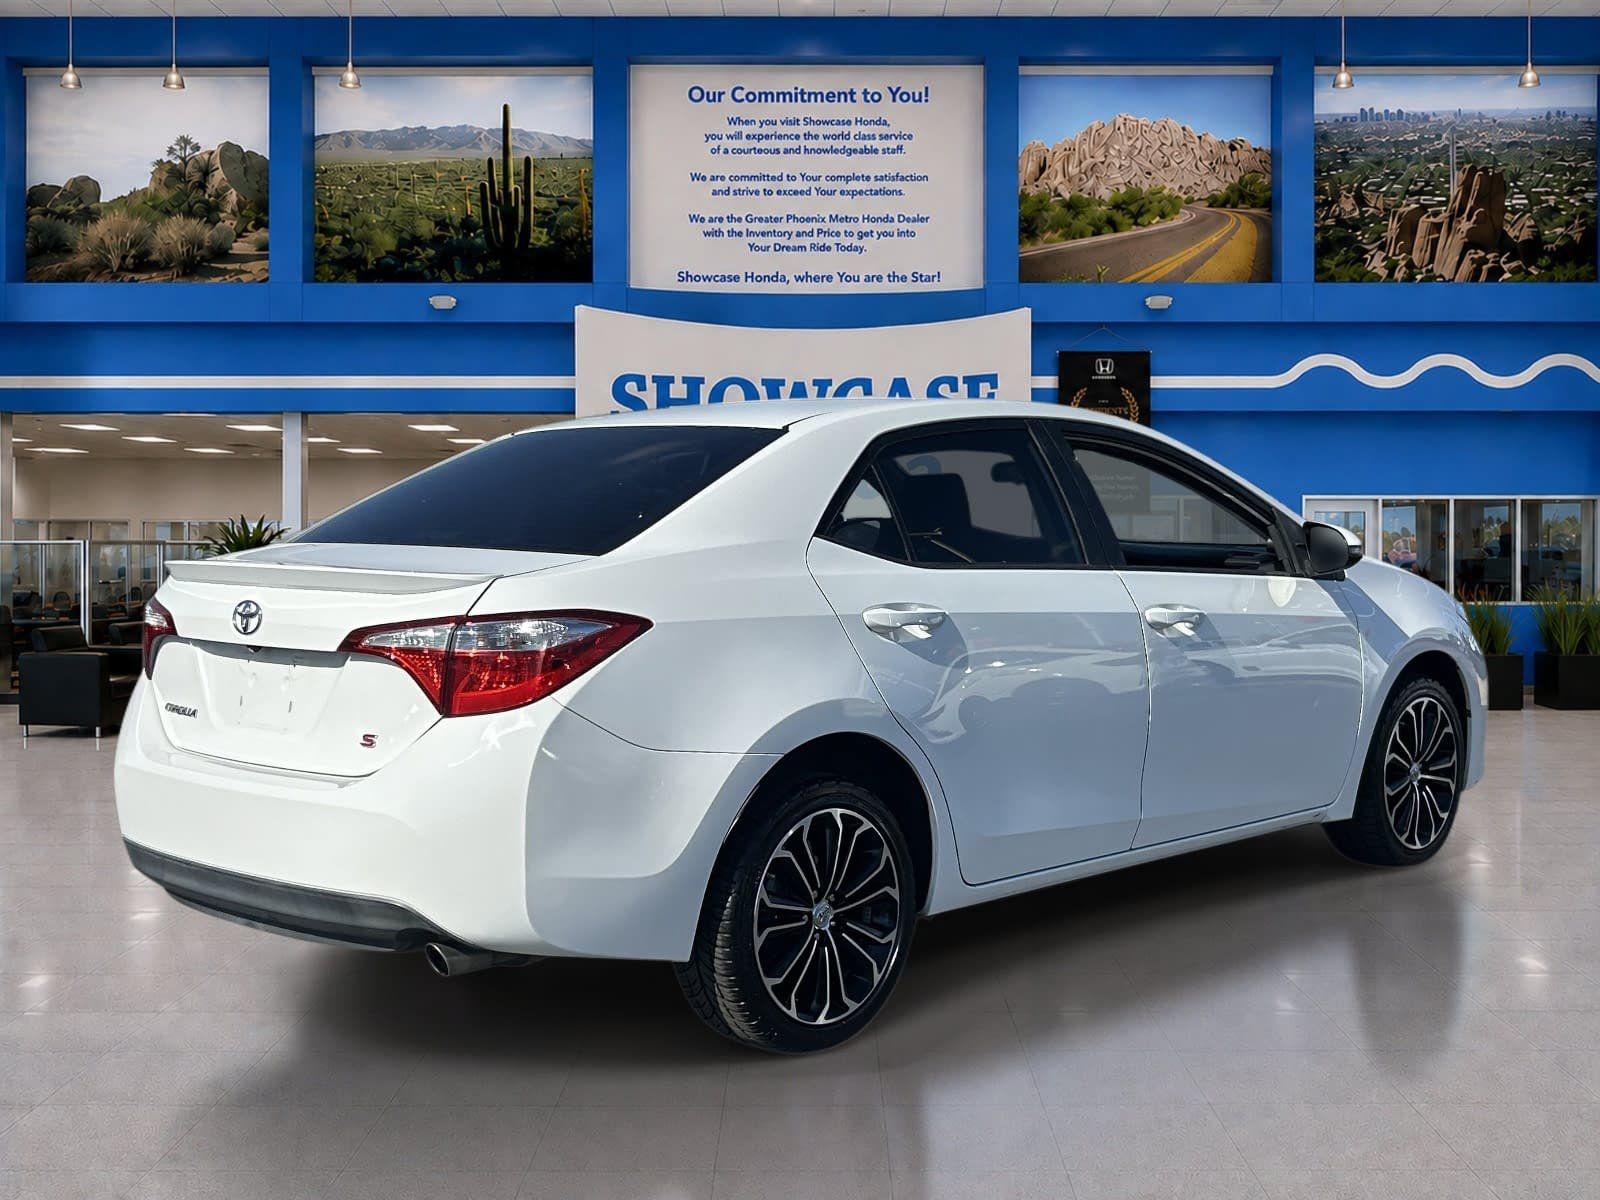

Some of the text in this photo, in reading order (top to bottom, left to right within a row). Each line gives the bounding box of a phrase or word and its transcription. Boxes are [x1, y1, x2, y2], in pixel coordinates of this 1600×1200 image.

[687, 84, 930, 103] Our Commitment to You!
[726, 116, 891, 128] When you visit Showcase Honda,
[704, 131, 914, 143] you will experience the world class service
[709, 145, 722, 155] of
[730, 147, 781, 155] courteous
[782, 145, 802, 155] and
[881, 144, 907, 155] staff.
[689, 172, 708, 182] We
[728, 172, 784, 182] committed
[785, 174, 798, 182] to
[799, 172, 823, 182] Your
[824, 172, 872, 185] complete
[873, 172, 929, 182] satisfaction
[711, 186, 906, 200] and strive to exceed Your expectations.
[688, 213, 931, 224] We are the Greater Phoenix Metro Honda Dealer
[702, 228, 917, 240] with the Inventory and Price to get you into
[747, 242, 868, 255] Your Dream Ride Today.
[676, 271, 941, 285] Showcase Honda, where You are the Star!
[360, 734, 378, 748] S
